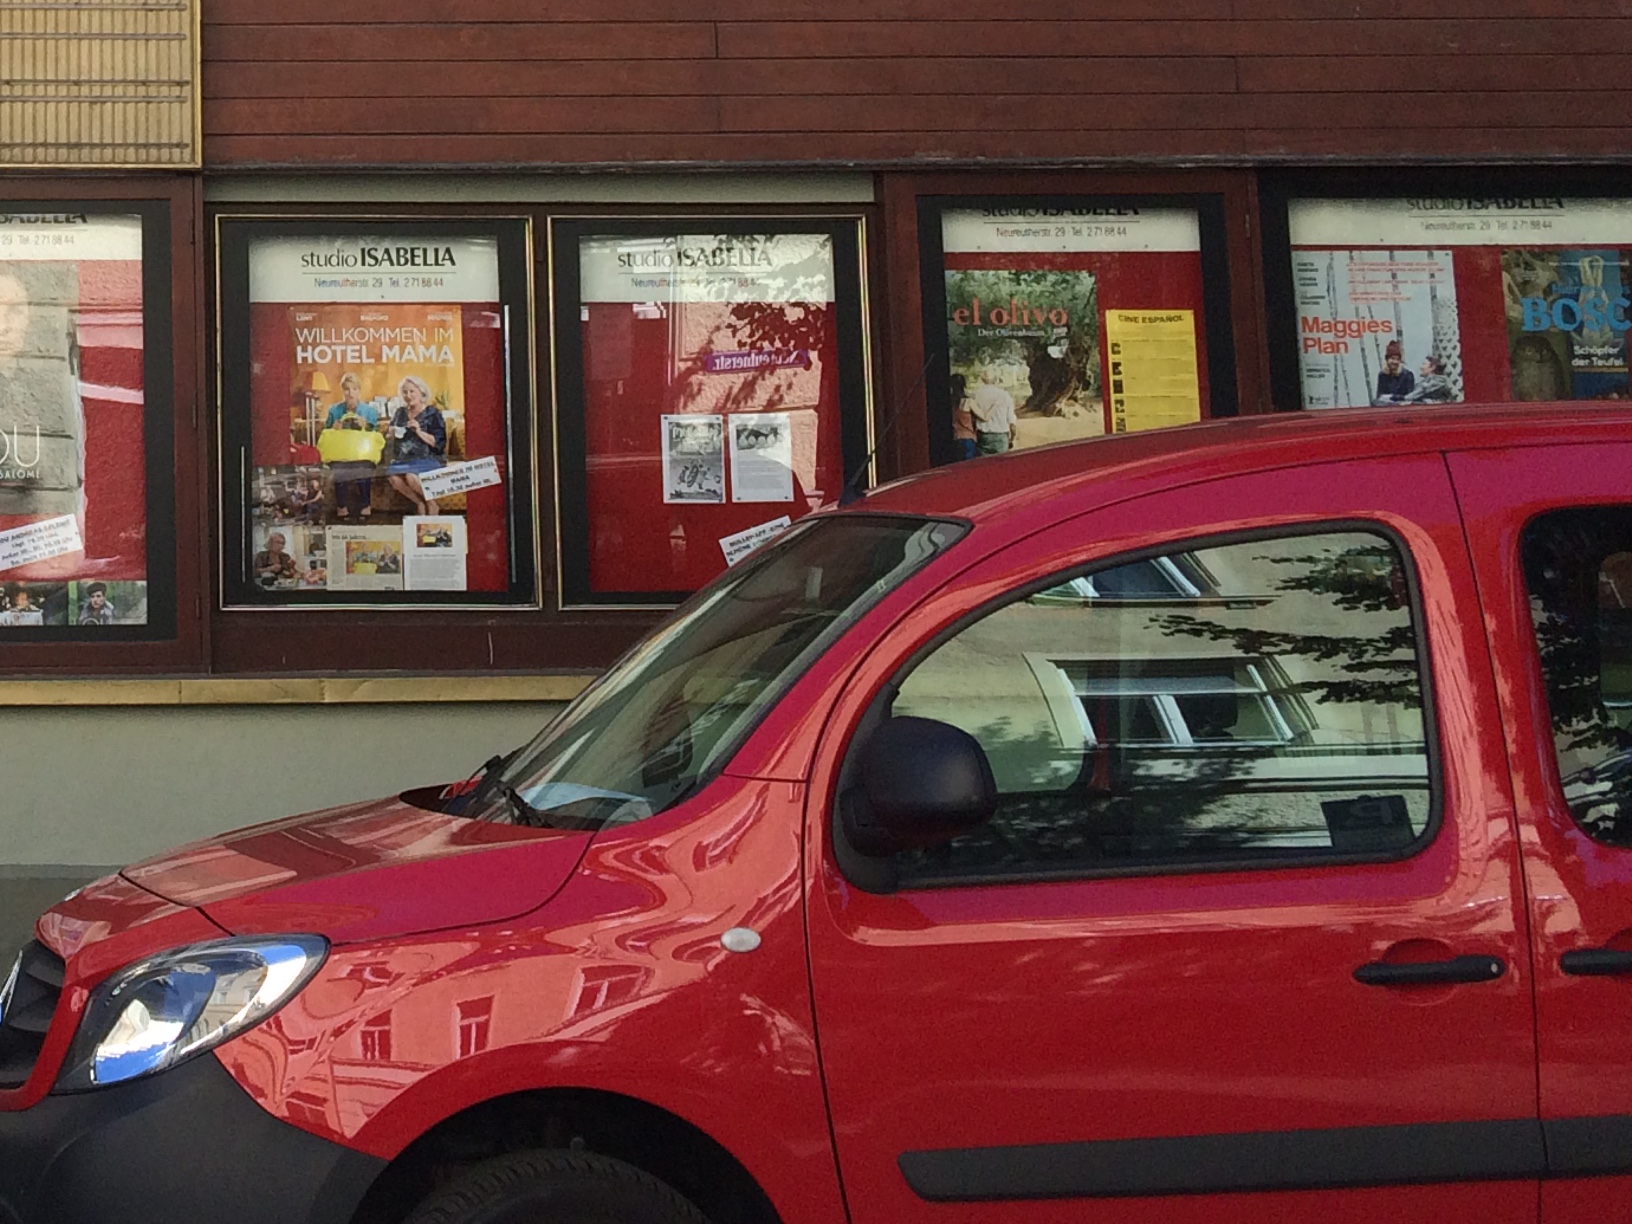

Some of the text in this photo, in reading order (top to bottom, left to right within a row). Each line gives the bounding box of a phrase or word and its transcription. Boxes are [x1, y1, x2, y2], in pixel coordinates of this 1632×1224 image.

[301, 247, 456, 267] studio ISABELLA
[618, 249, 674, 267] studio
[372, 278, 383, 287] 29
[952, 296, 1068, 326] el olivo
[295, 327, 454, 343] WILLKOMMEN IM
[1301, 316, 1392, 338] Maggies
[296, 345, 455, 364] HOTEL MAMA
[1303, 337, 1349, 354] Plan
[1571, 356, 1624, 366] der Teufel
